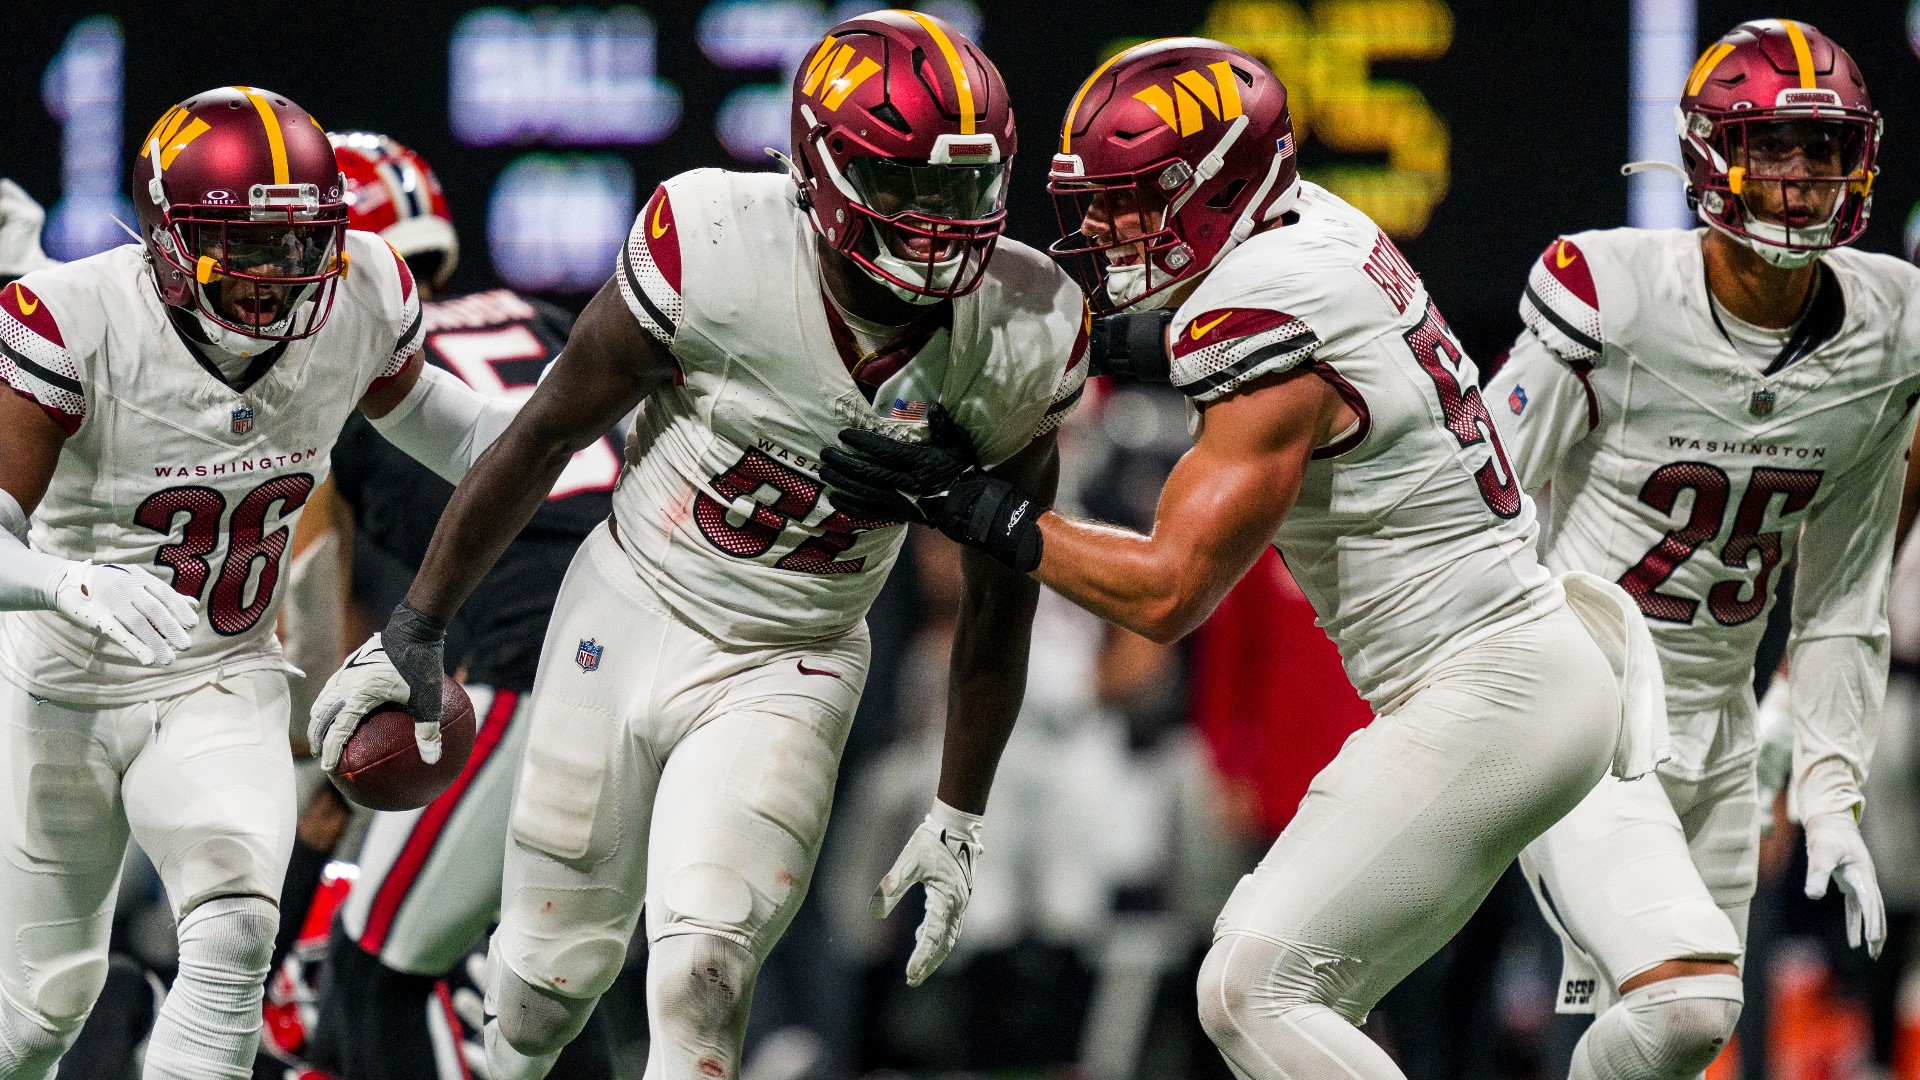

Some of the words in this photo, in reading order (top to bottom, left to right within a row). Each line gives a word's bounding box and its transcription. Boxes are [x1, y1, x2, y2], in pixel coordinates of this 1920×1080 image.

[154, 447, 318, 478] WASHINGTON
[1669, 436, 1826, 459] WASHINGTON
[132, 472, 315, 637] 36
[1617, 460, 1826, 627] 25
